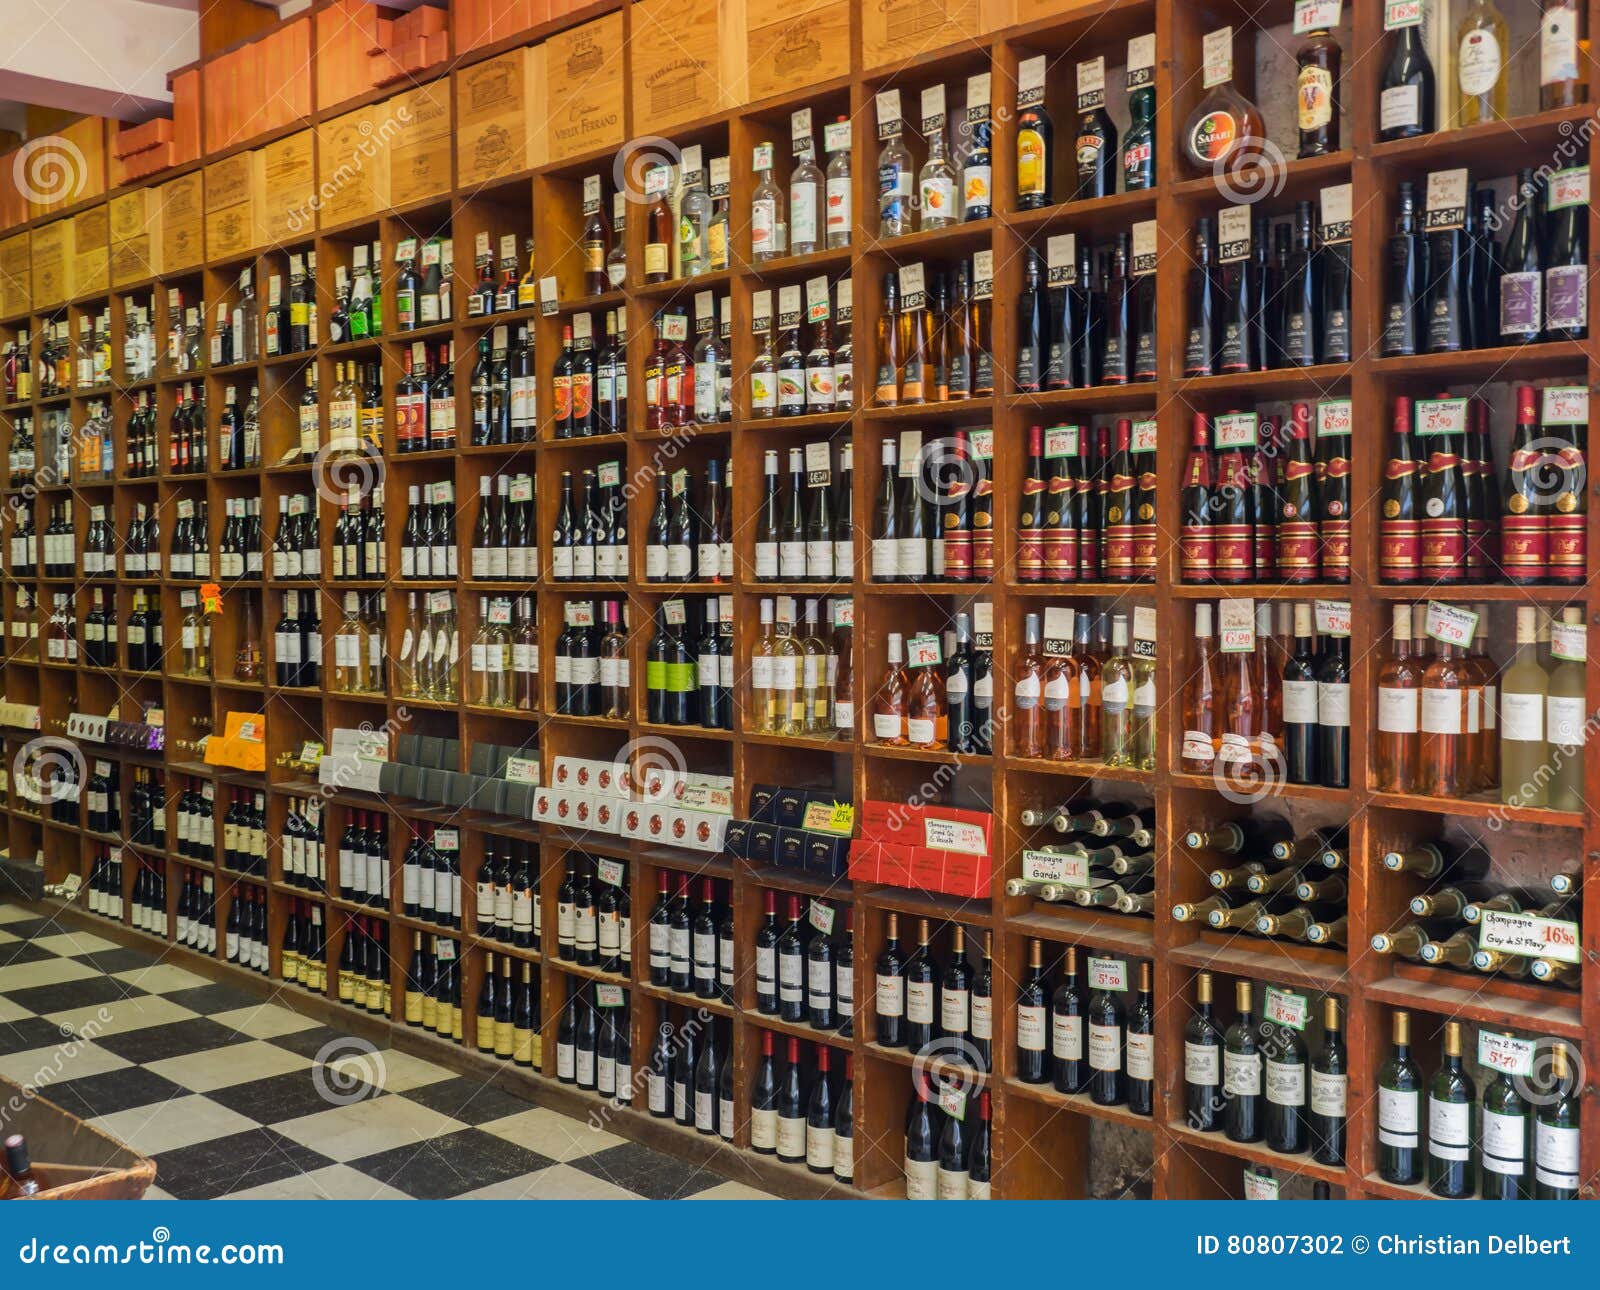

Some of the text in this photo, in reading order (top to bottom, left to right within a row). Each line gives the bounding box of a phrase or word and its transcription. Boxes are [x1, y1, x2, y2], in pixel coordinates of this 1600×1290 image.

[580, 114, 618, 137] FERRAND
[1198, 131, 1232, 146] SAFARI
[1026, 852, 1063, 866] Champagne
[1486, 912, 1533, 928] Champagne
[1486, 934, 1504, 946] Guy
[1503, 1039, 1510, 1048] 2
